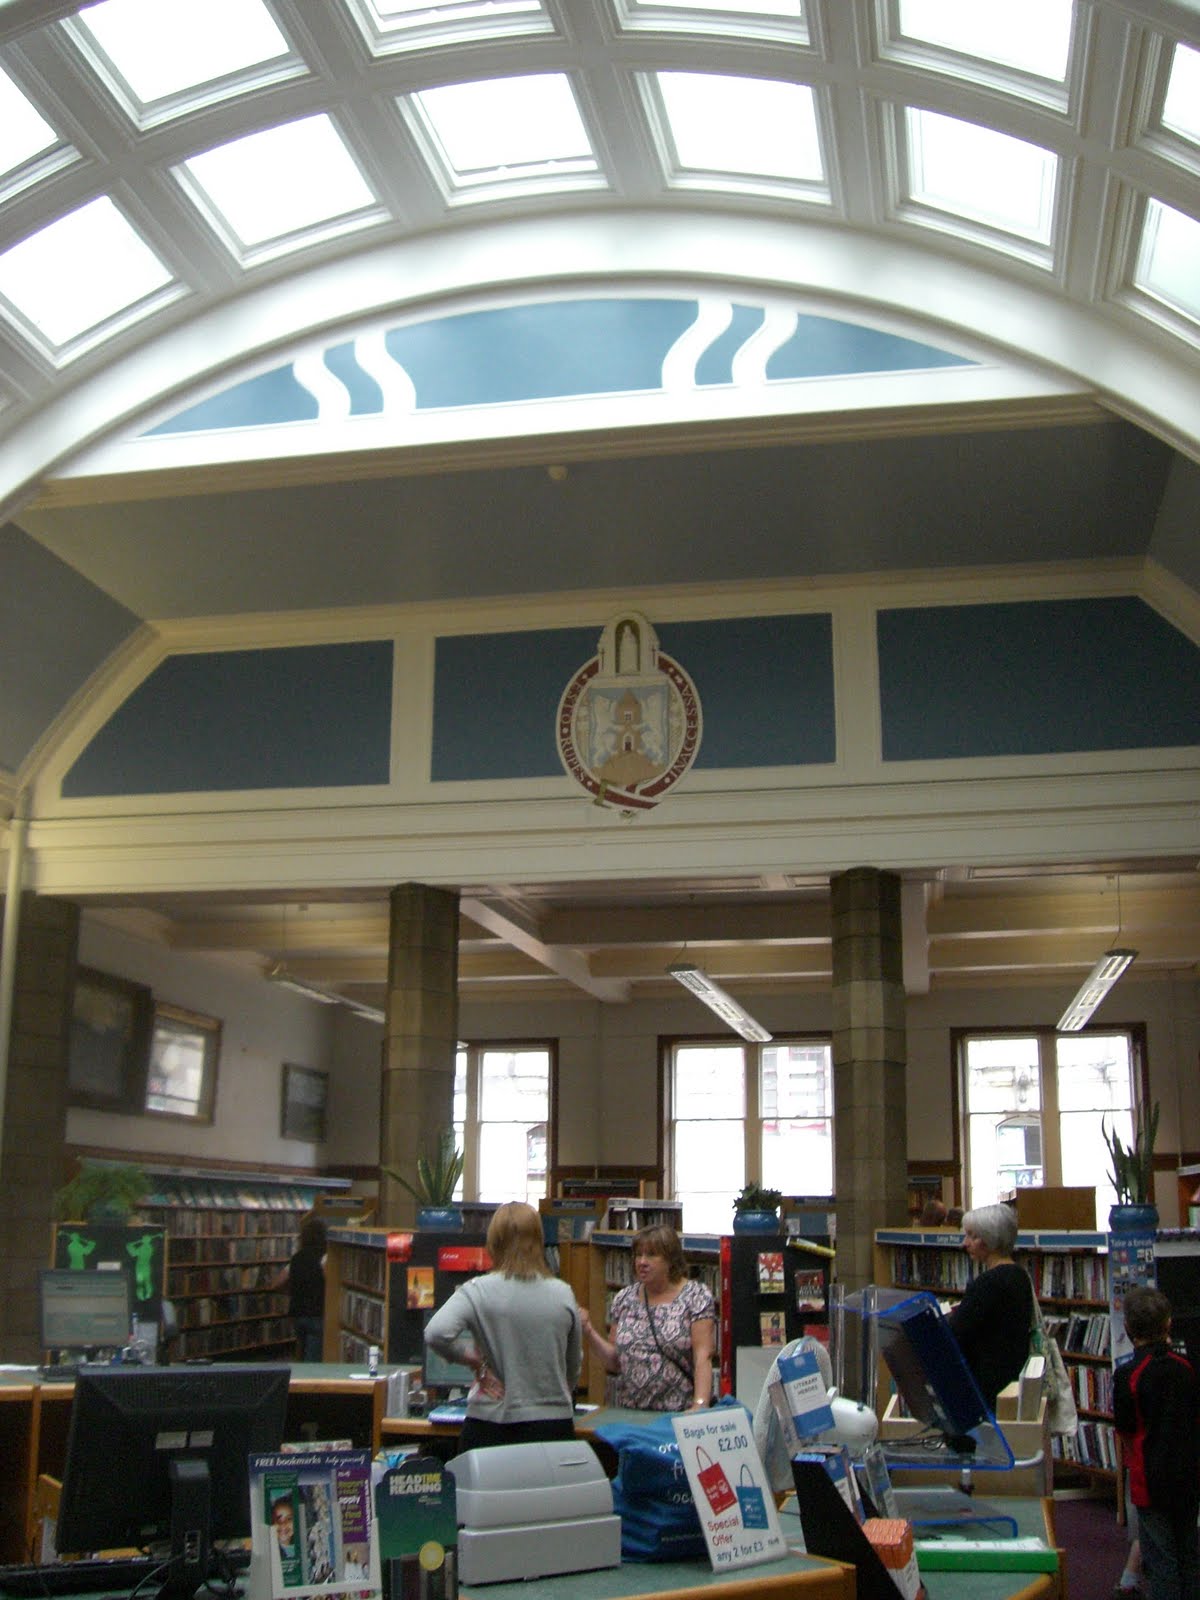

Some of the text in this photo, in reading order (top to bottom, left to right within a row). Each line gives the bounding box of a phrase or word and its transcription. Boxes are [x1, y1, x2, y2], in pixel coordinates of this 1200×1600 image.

[683, 1421, 736, 1439] Bags for sale
[718, 1435, 748, 1452] £2.00
[254, 1457, 274, 1468] FREE
[276, 1455, 321, 1467] bookmarks
[707, 1516, 740, 1533] Special
[712, 1534, 734, 1547] Offer
[716, 1548, 732, 1562] any
[733, 1546, 740, 1557] 2
[741, 1544, 752, 1556] for
[753, 1541, 764, 1553] £3
